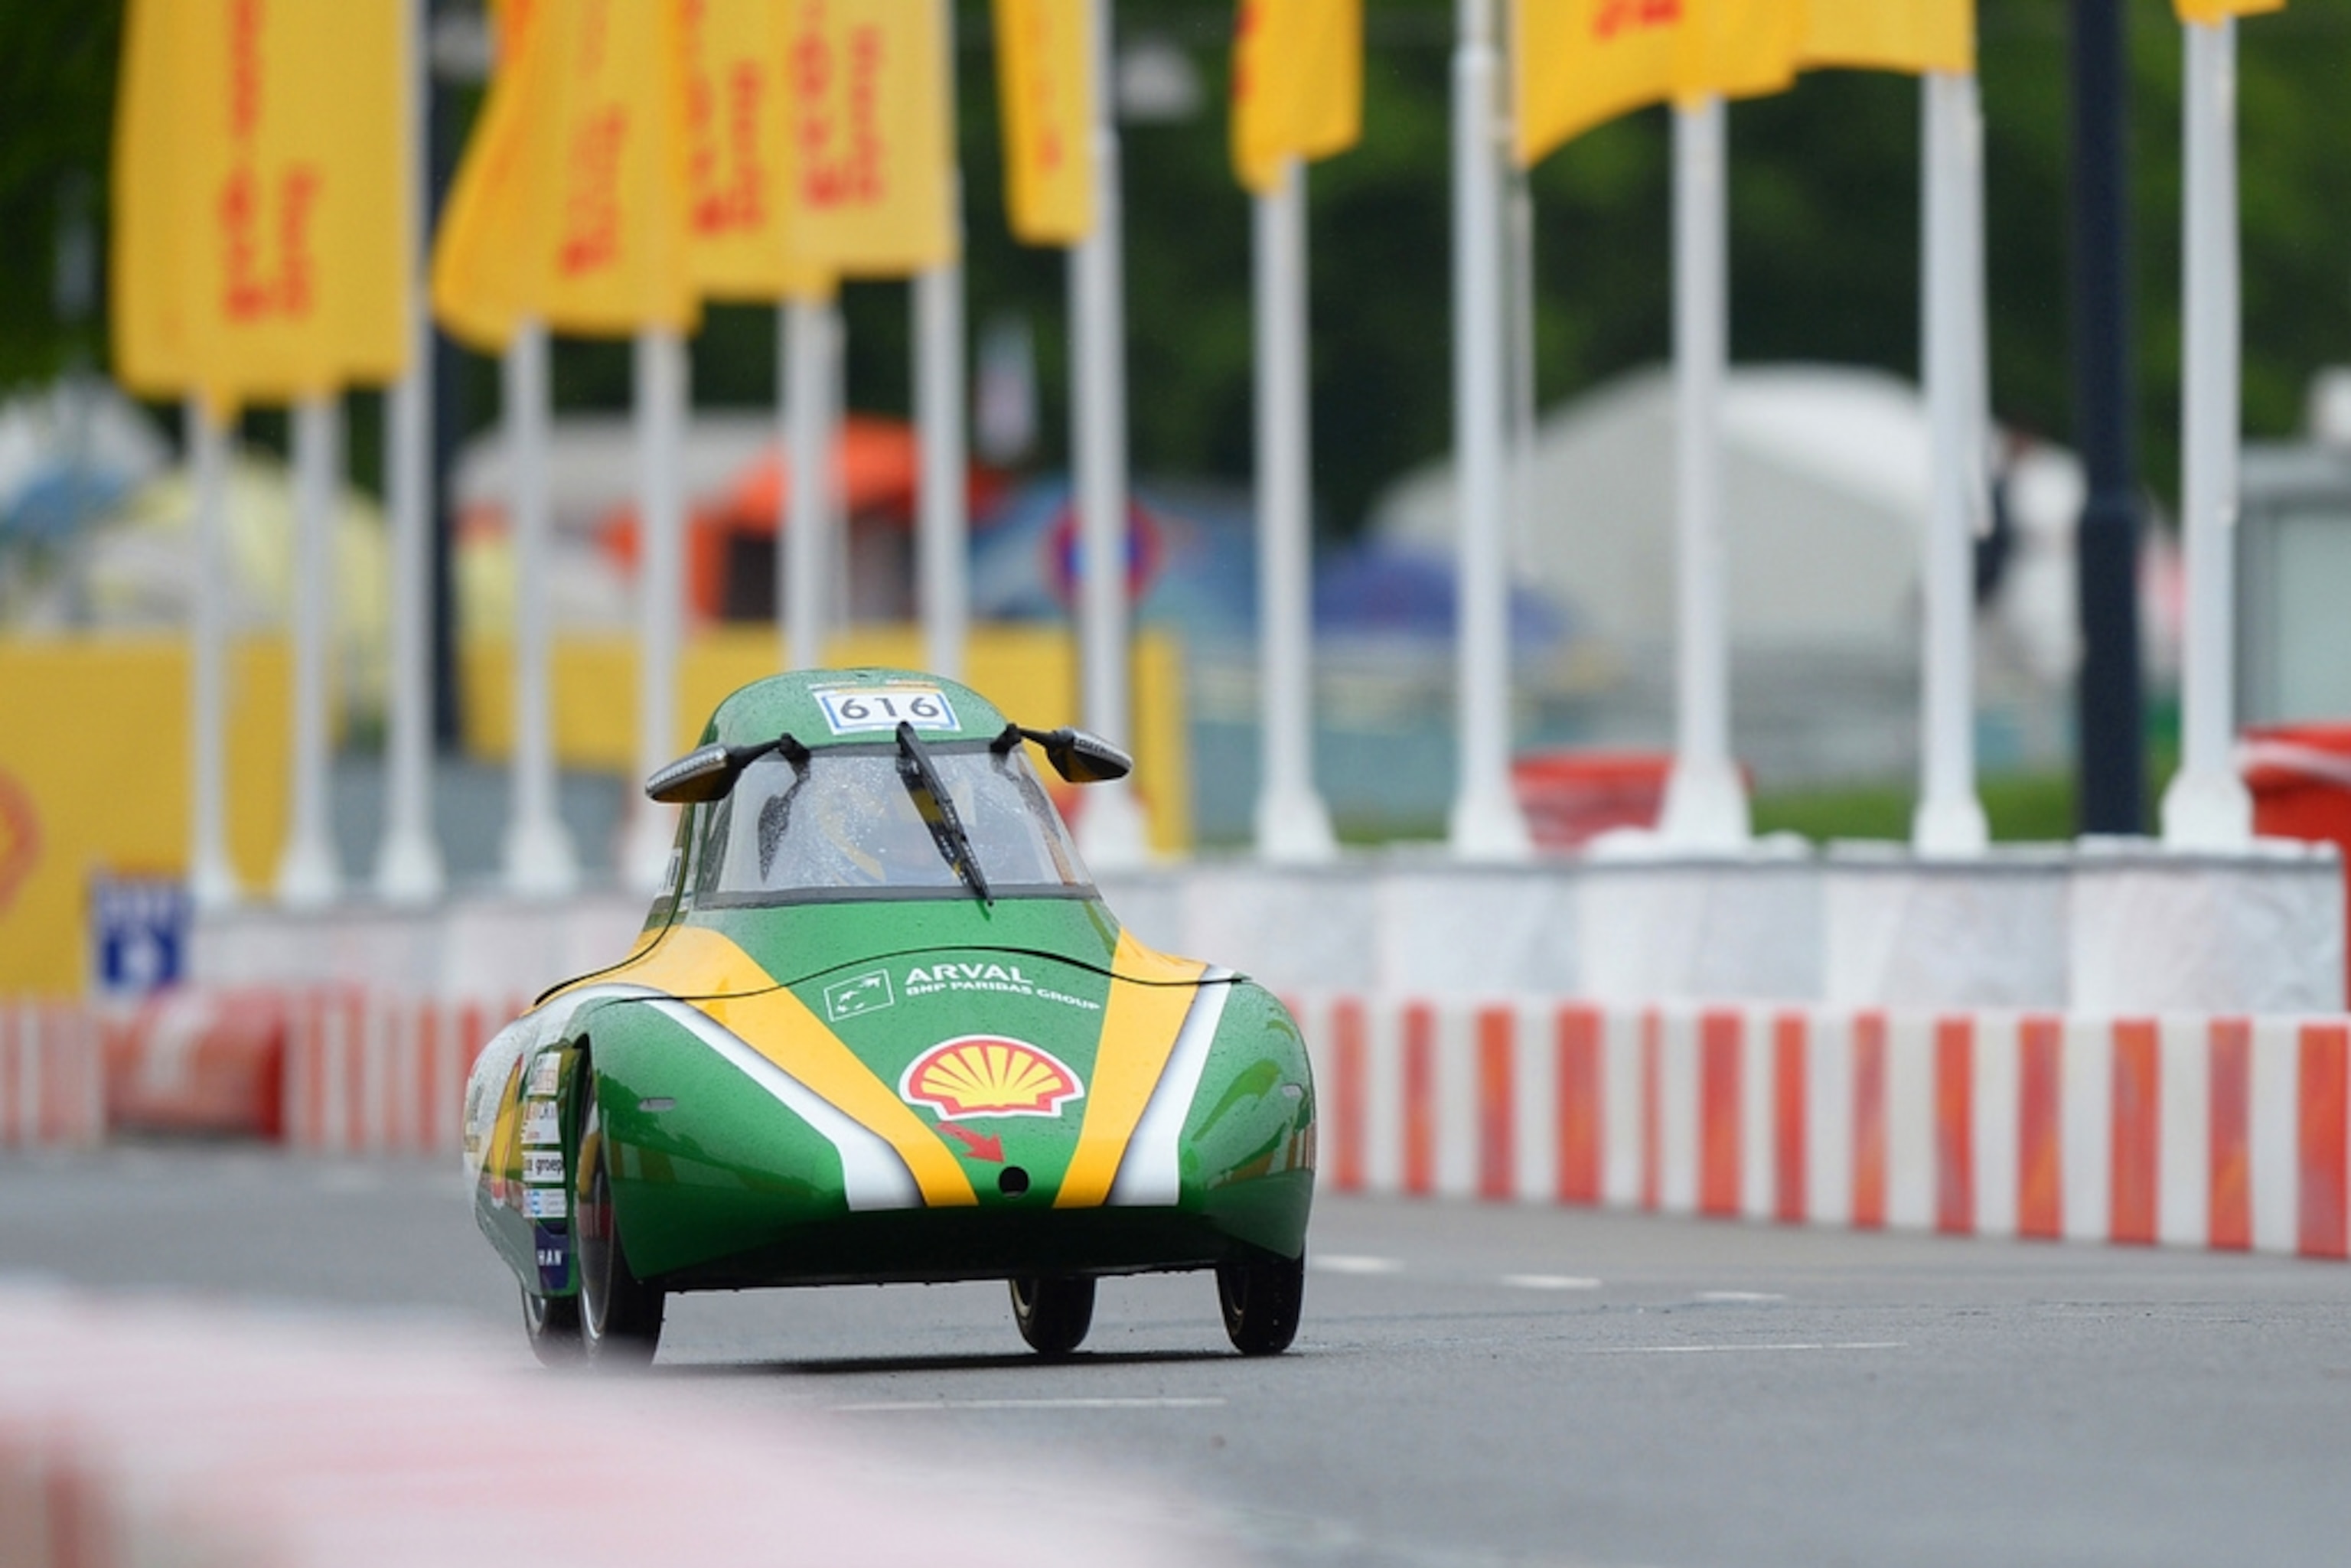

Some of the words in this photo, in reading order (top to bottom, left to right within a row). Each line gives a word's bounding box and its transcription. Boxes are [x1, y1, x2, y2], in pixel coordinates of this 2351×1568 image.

[840, 697, 940, 719] 616
[905, 963, 1033, 986] ARVAL
[906, 982, 947, 996] BNP
[951, 980, 1033, 995] PARIBAS
[1036, 989, 1101, 1009] GROUP
[537, 1249, 562, 1266] HAN
